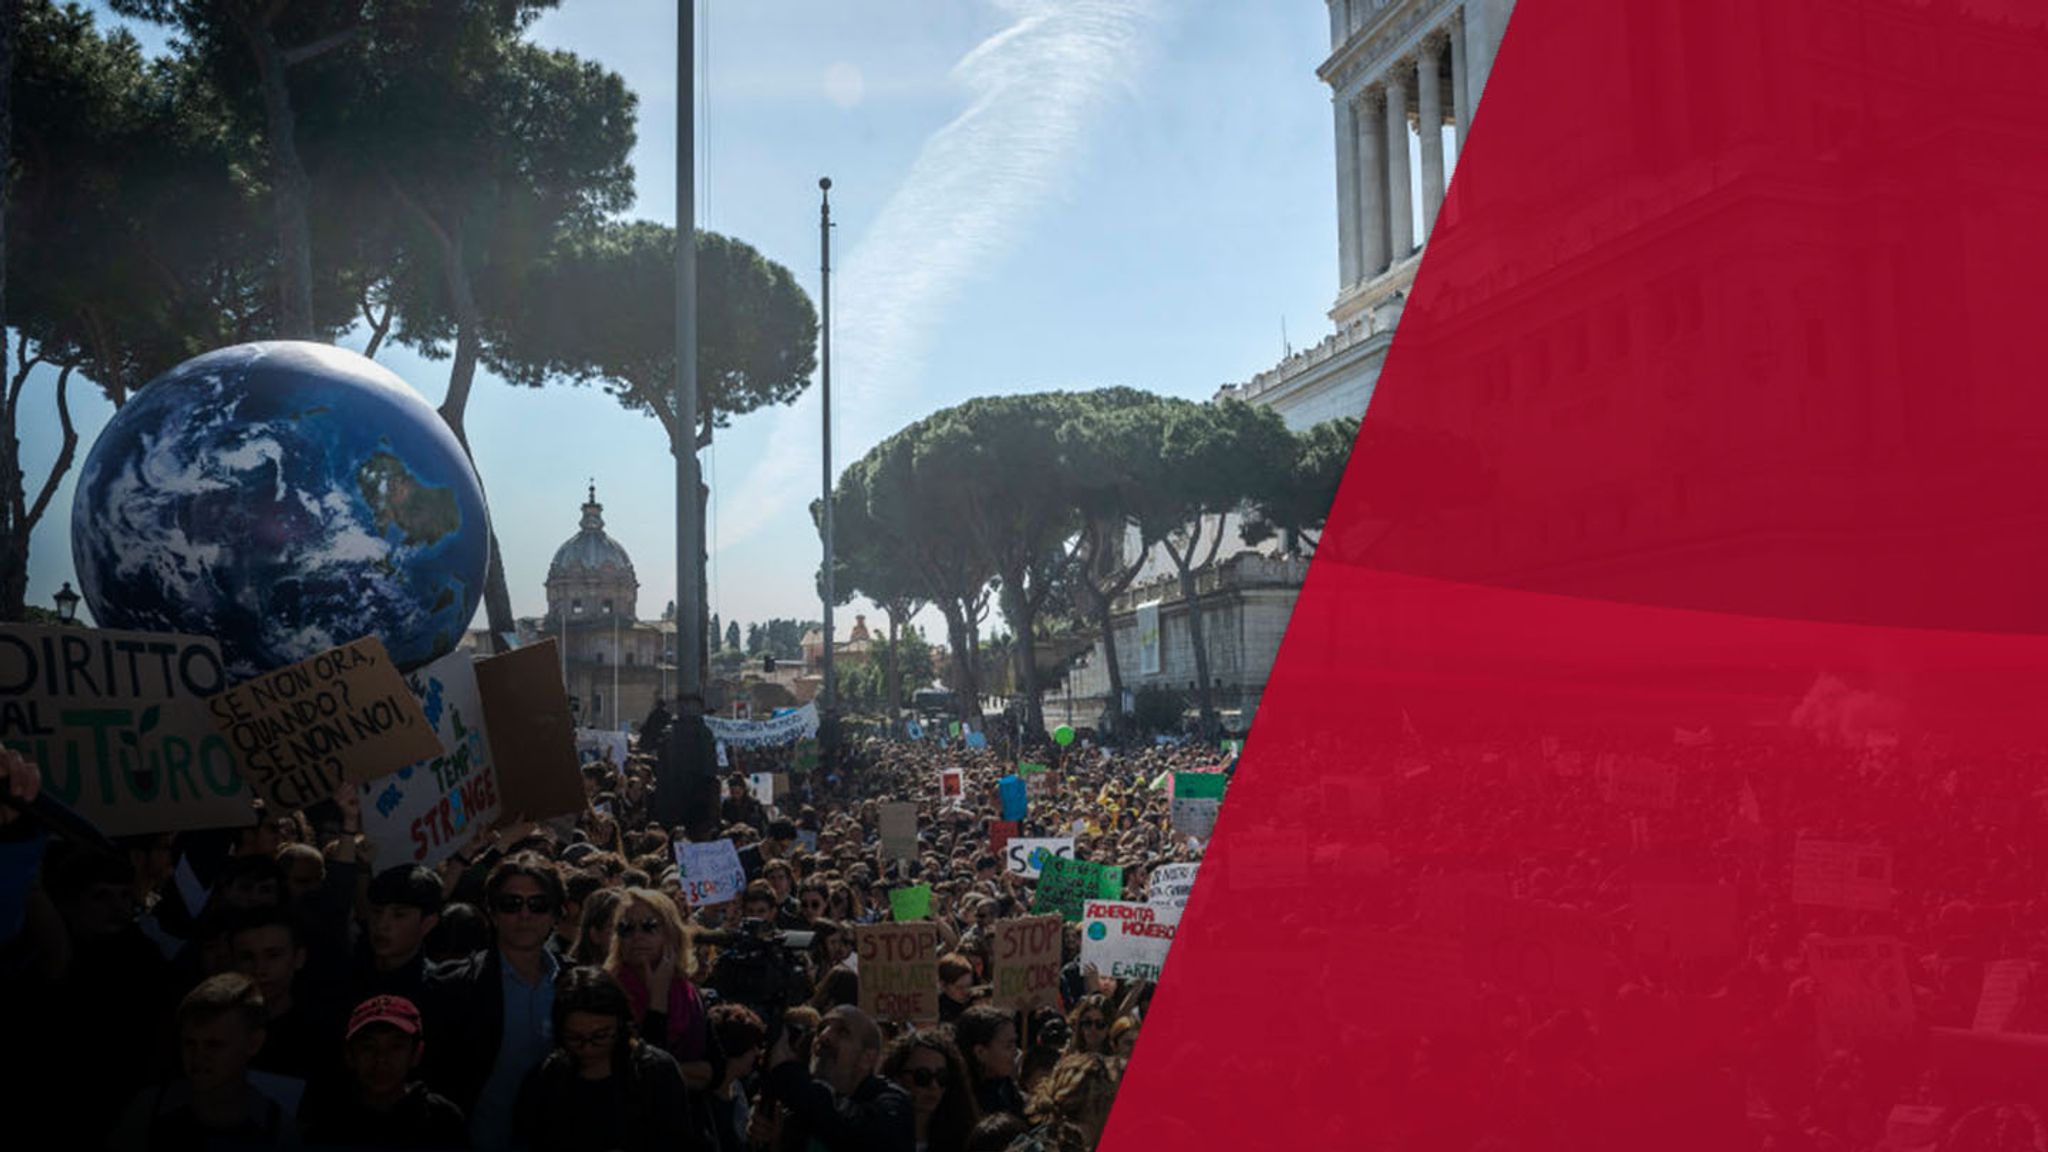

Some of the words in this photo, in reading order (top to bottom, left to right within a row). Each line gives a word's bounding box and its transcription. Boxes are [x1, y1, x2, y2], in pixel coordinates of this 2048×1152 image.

[0, 634, 225, 698] DIRITTO
[211, 692, 252, 731] SE
[252, 665, 313, 710] NON
[314, 648, 375, 680] ORA,
[0, 700, 54, 735] AL
[232, 680, 354, 751] QUANDO?
[248, 745, 296, 783] SE
[289, 718, 352, 765] NON
[346, 695, 414, 740] NOI,
[3, 708, 242, 806] UTURO
[272, 757, 344, 809] CHI?
[861, 932, 935, 962] STOP
[1002, 918, 1060, 960] STOP
[1112, 961, 1161, 980] EARTH
